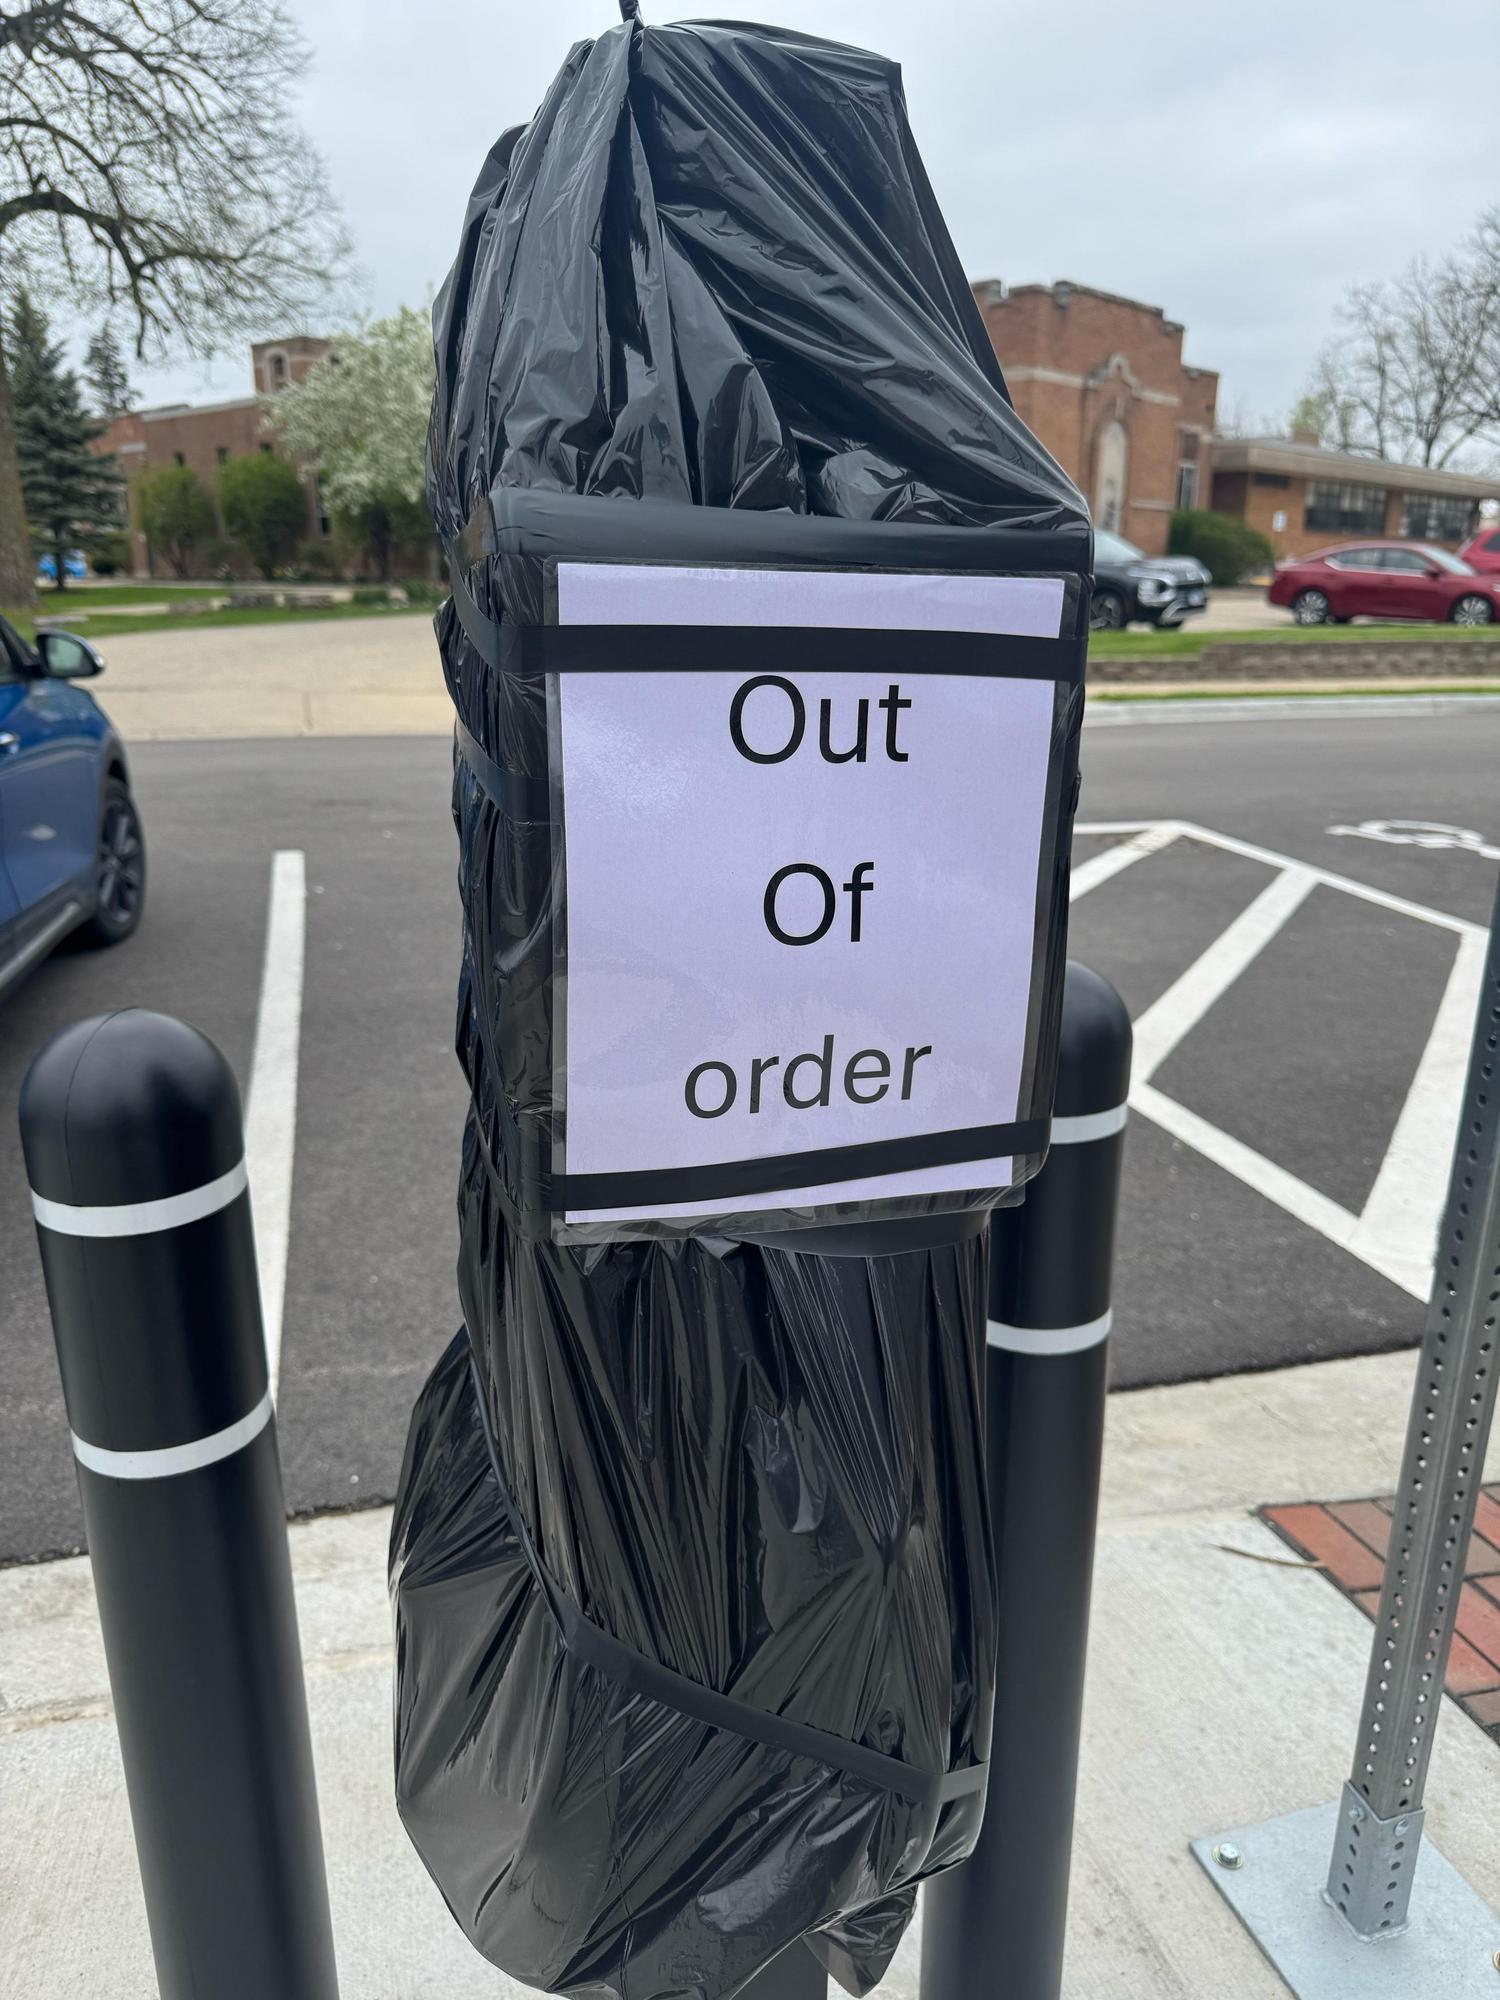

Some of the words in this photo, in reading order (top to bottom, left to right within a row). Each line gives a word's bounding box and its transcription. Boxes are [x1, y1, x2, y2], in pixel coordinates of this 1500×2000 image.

[729, 674, 913, 766] Out
[763, 860, 876, 947] Of
[683, 1034, 934, 1120] order
